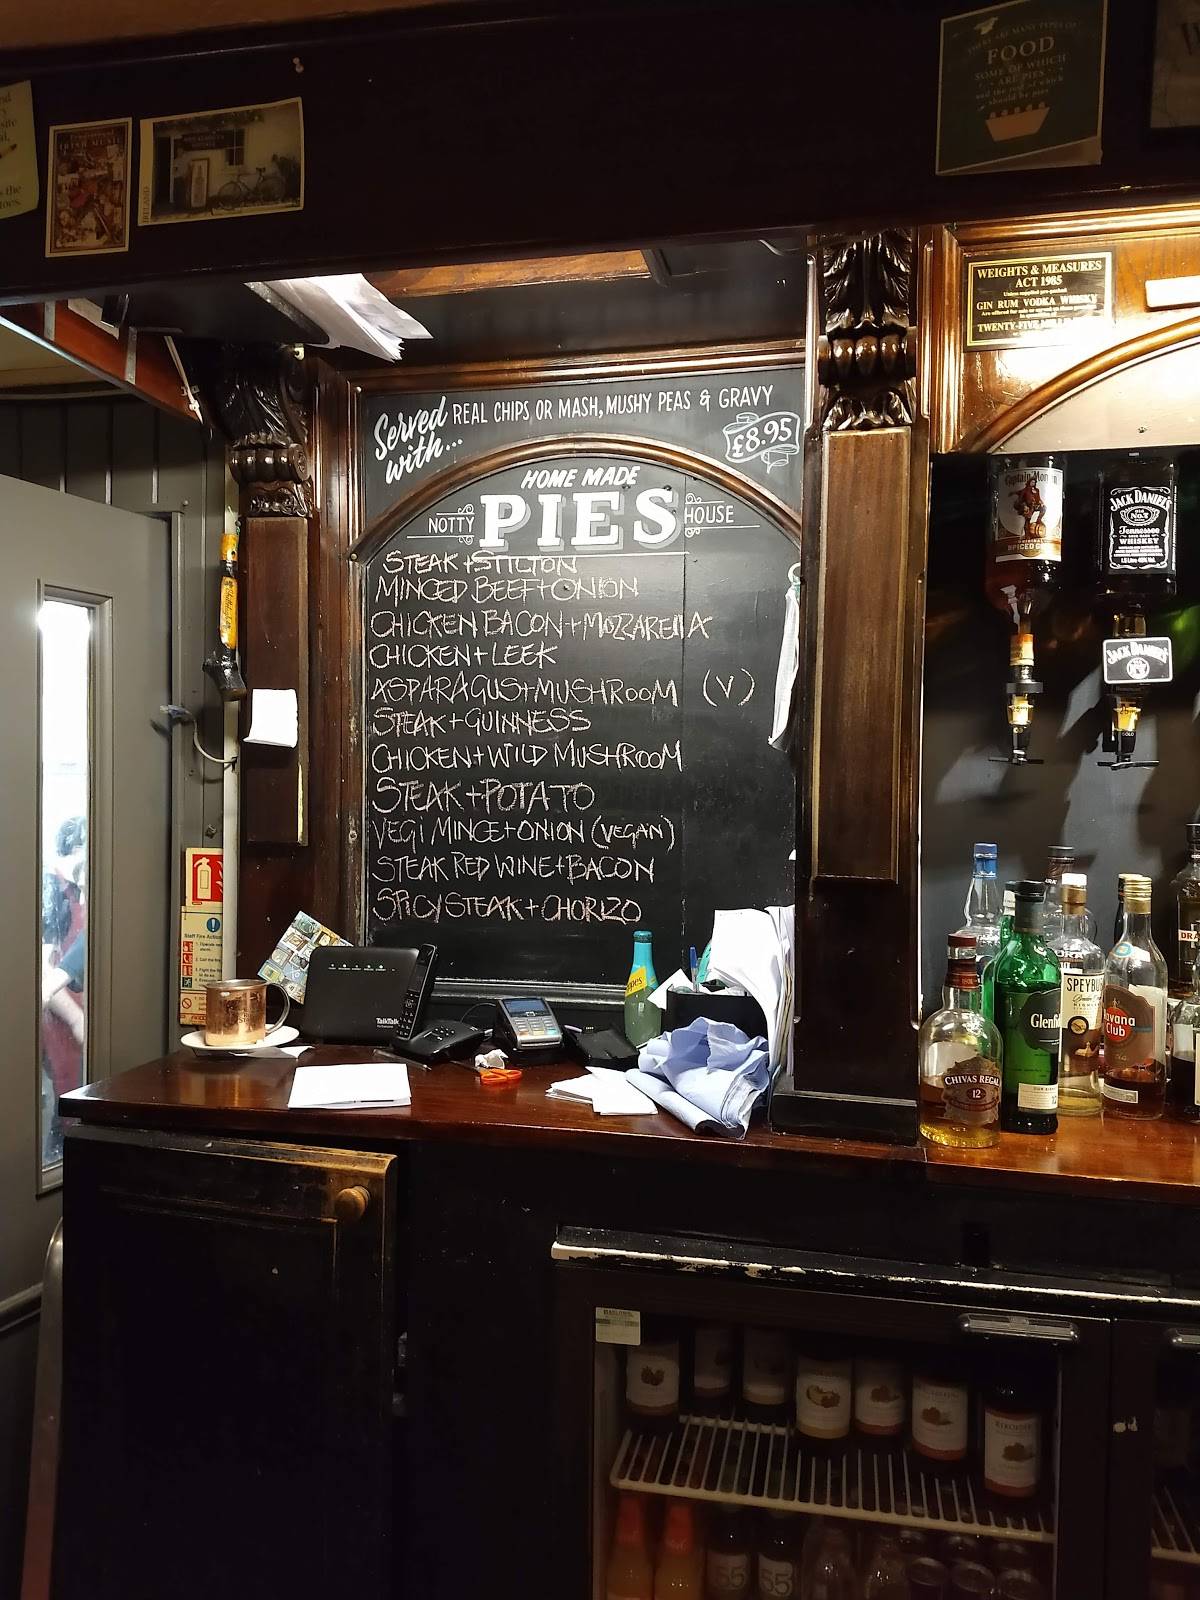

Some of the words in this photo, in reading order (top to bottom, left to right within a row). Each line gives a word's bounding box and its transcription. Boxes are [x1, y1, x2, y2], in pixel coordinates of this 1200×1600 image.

[987, 35, 1056, 65] FOOD
[974, 68, 1003, 81] SOME
[1026, 53, 1067, 69] WHICH
[977, 265, 1029, 279] WEIGHTS
[1030, 264, 1040, 275] &
[1042, 260, 1103, 275] MEASURES
[1015, 277, 1039, 289] ACT
[1040, 275, 1063, 287] 1985
[976, 301, 993, 311] GIN
[997, 299, 1019, 309] RUM
[1023, 296, 1056, 307] VODKA
[453, 402, 488, 425] REAL
[493, 400, 530, 423] CHIPS
[535, 398, 553, 420] OR
[558, 395, 604, 419] MASH,
[606, 392, 653, 414] MUSHY
[657, 390, 692, 412] PEAS
[699, 389, 711, 411] &
[718, 384, 774, 409] GRAVY
[373, 395, 449, 460] Served
[731, 417, 793, 459] £8.95
[520, 468, 577, 490] HOME
[580, 465, 641, 488] MADE
[1110, 493, 1134, 511] JACK
[428, 515, 475, 534] NOTTY
[479, 487, 683, 552] PIES
[684, 503, 735, 525] HOUSE
[1119, 525, 1160, 535] Tennessee
[382, 550, 459, 575] STEAK
[375, 574, 468, 608] MINCED
[369, 609, 479, 639] CHICKEN
[1106, 644, 1131, 665] JACK
[554, 738, 683, 773] MUSHROOM
[371, 776, 465, 814] STEAK
[371, 855, 450, 883] STEAK
[451, 851, 491, 882] RED
[375, 1017, 400, 1026] TalkTalk
[1105, 1022, 1127, 1038] Club
[944, 1075, 978, 1086] CHIVAS
[979, 1075, 1000, 1086] REGAL
[972, 1089, 981, 1099] 12
